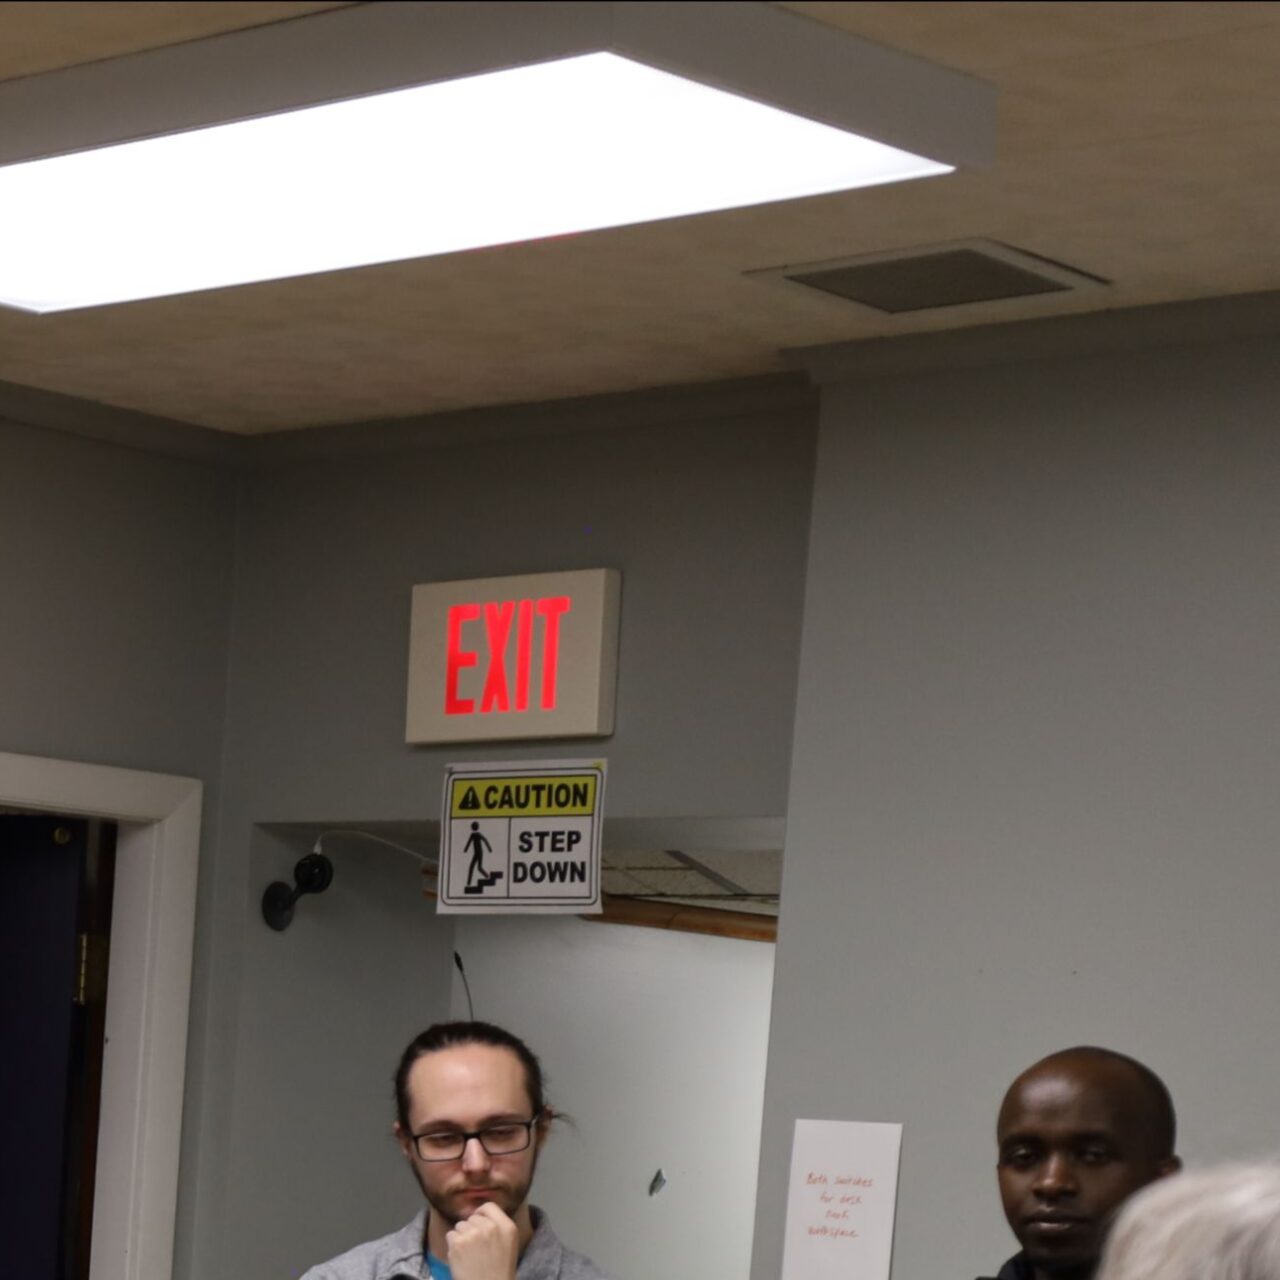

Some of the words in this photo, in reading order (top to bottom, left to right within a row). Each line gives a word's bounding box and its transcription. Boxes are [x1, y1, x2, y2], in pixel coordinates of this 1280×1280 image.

[444, 595, 572, 715] EXIT
[483, 783, 589, 810] CAUTION
[518, 831, 582, 853] STEP
[512, 861, 586, 883] DOWN
